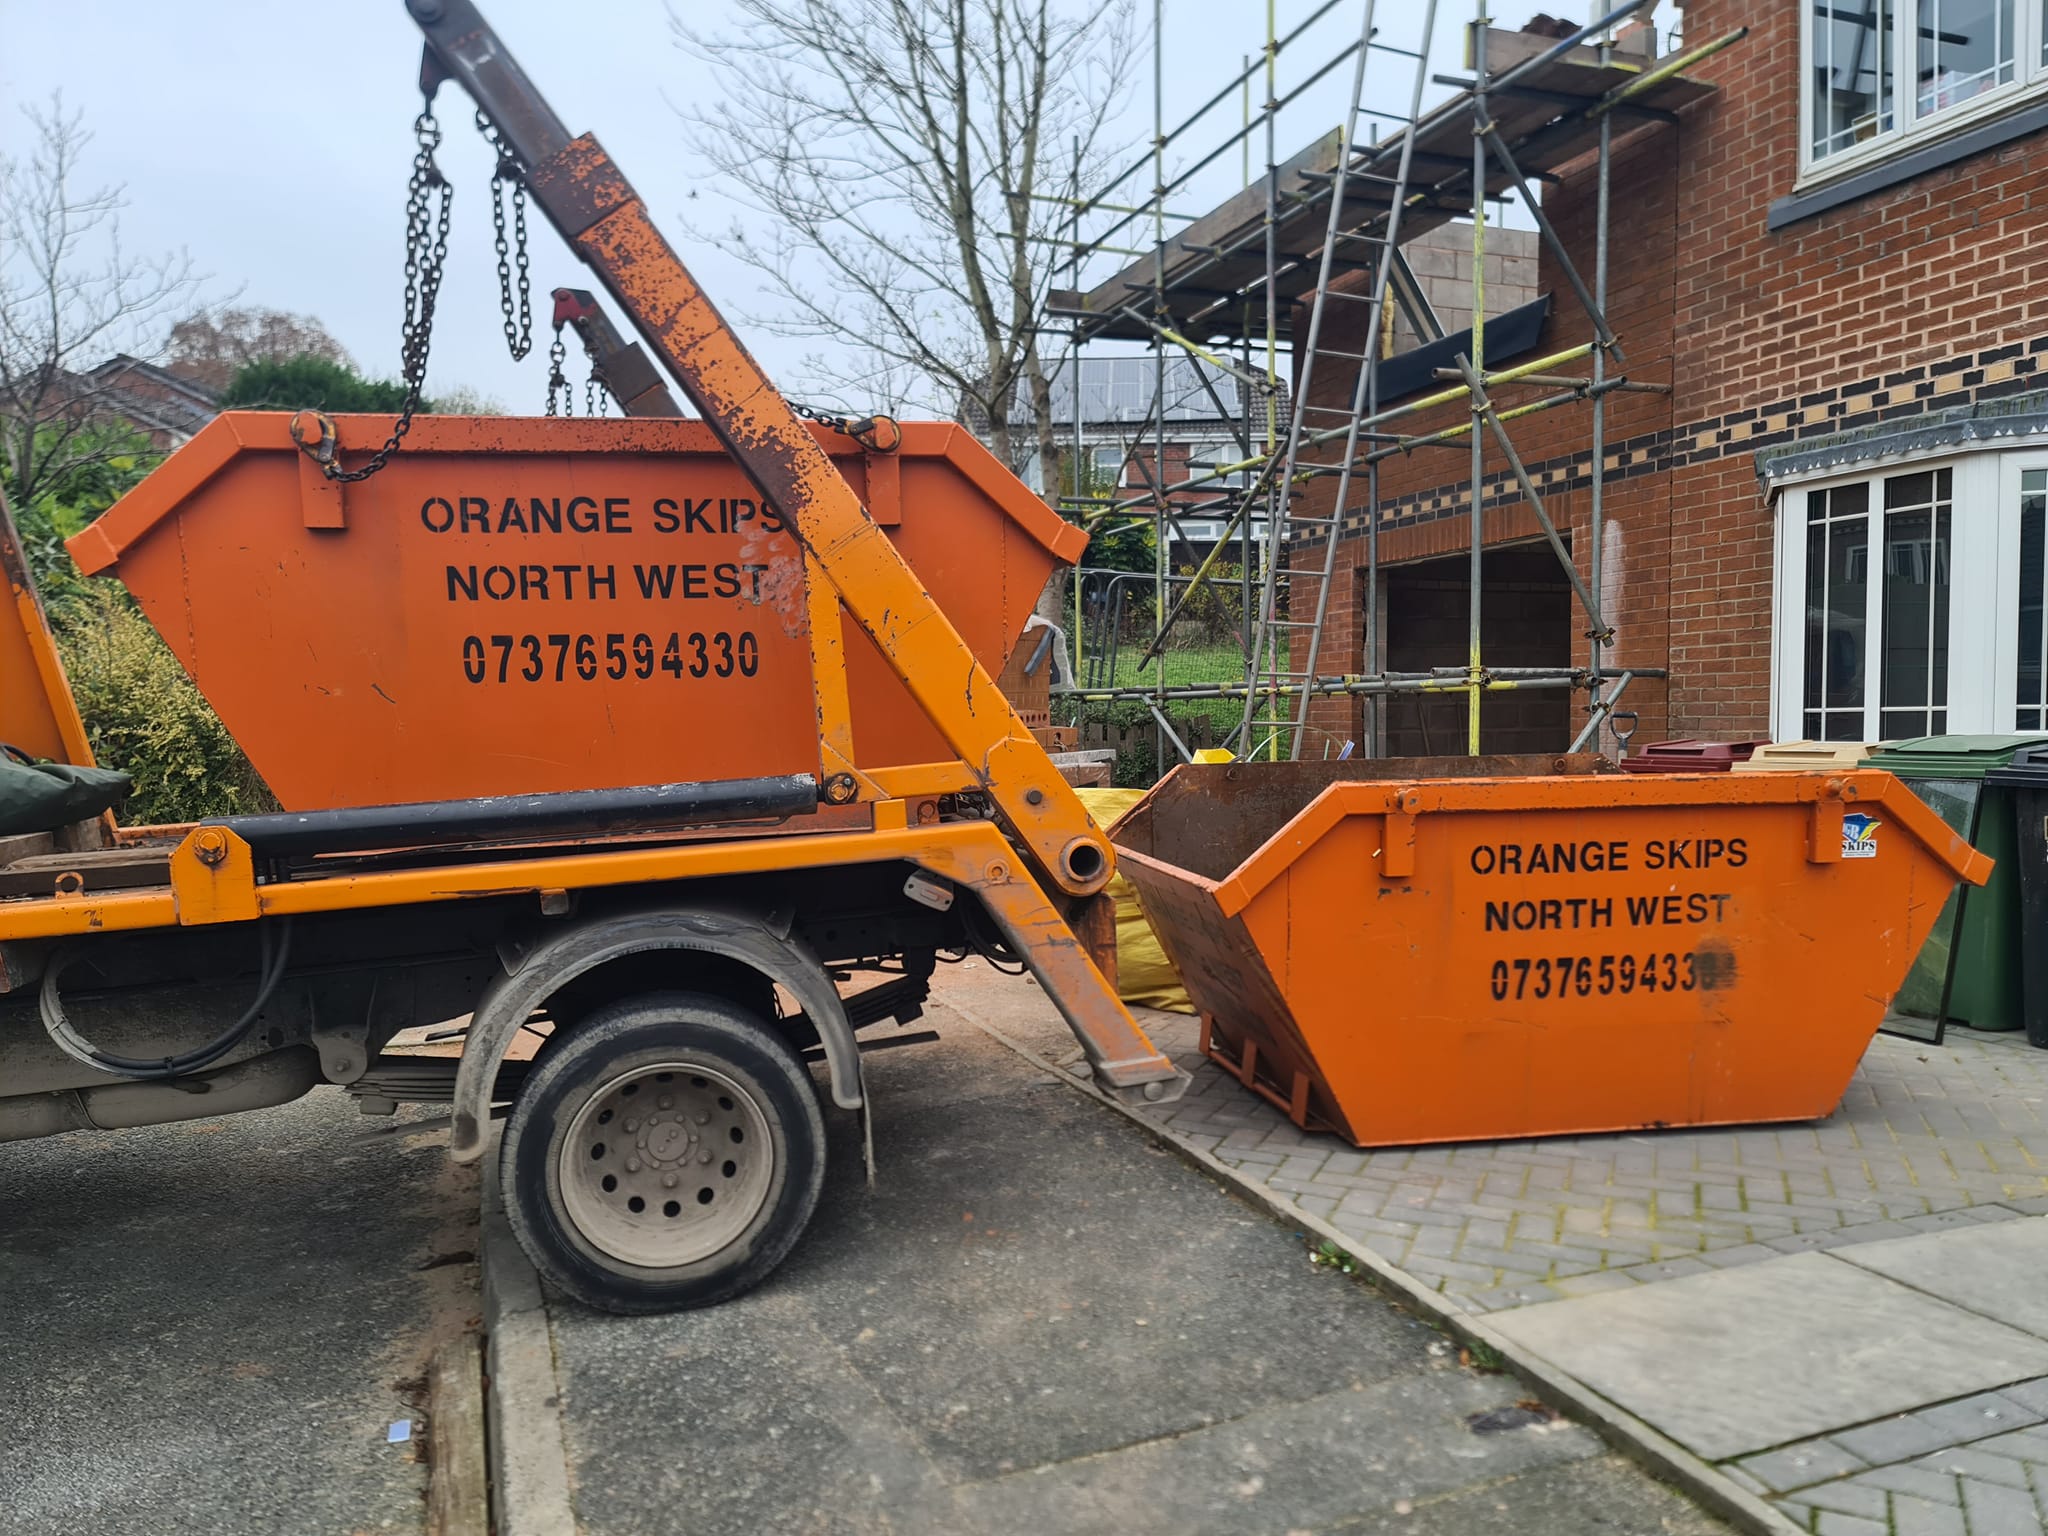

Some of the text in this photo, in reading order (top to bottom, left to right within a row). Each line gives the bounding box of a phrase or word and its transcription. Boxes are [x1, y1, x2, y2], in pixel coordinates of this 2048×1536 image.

[421, 497, 785, 534] ORANGE SKIPS
[446, 563, 769, 605] NORTH WEST
[463, 631, 759, 684] 07376594330
[1471, 838, 1748, 875] ORANGE SKIPS
[1842, 841, 1875, 851] SKIPS
[1485, 893, 1731, 931] NORTH WEST
